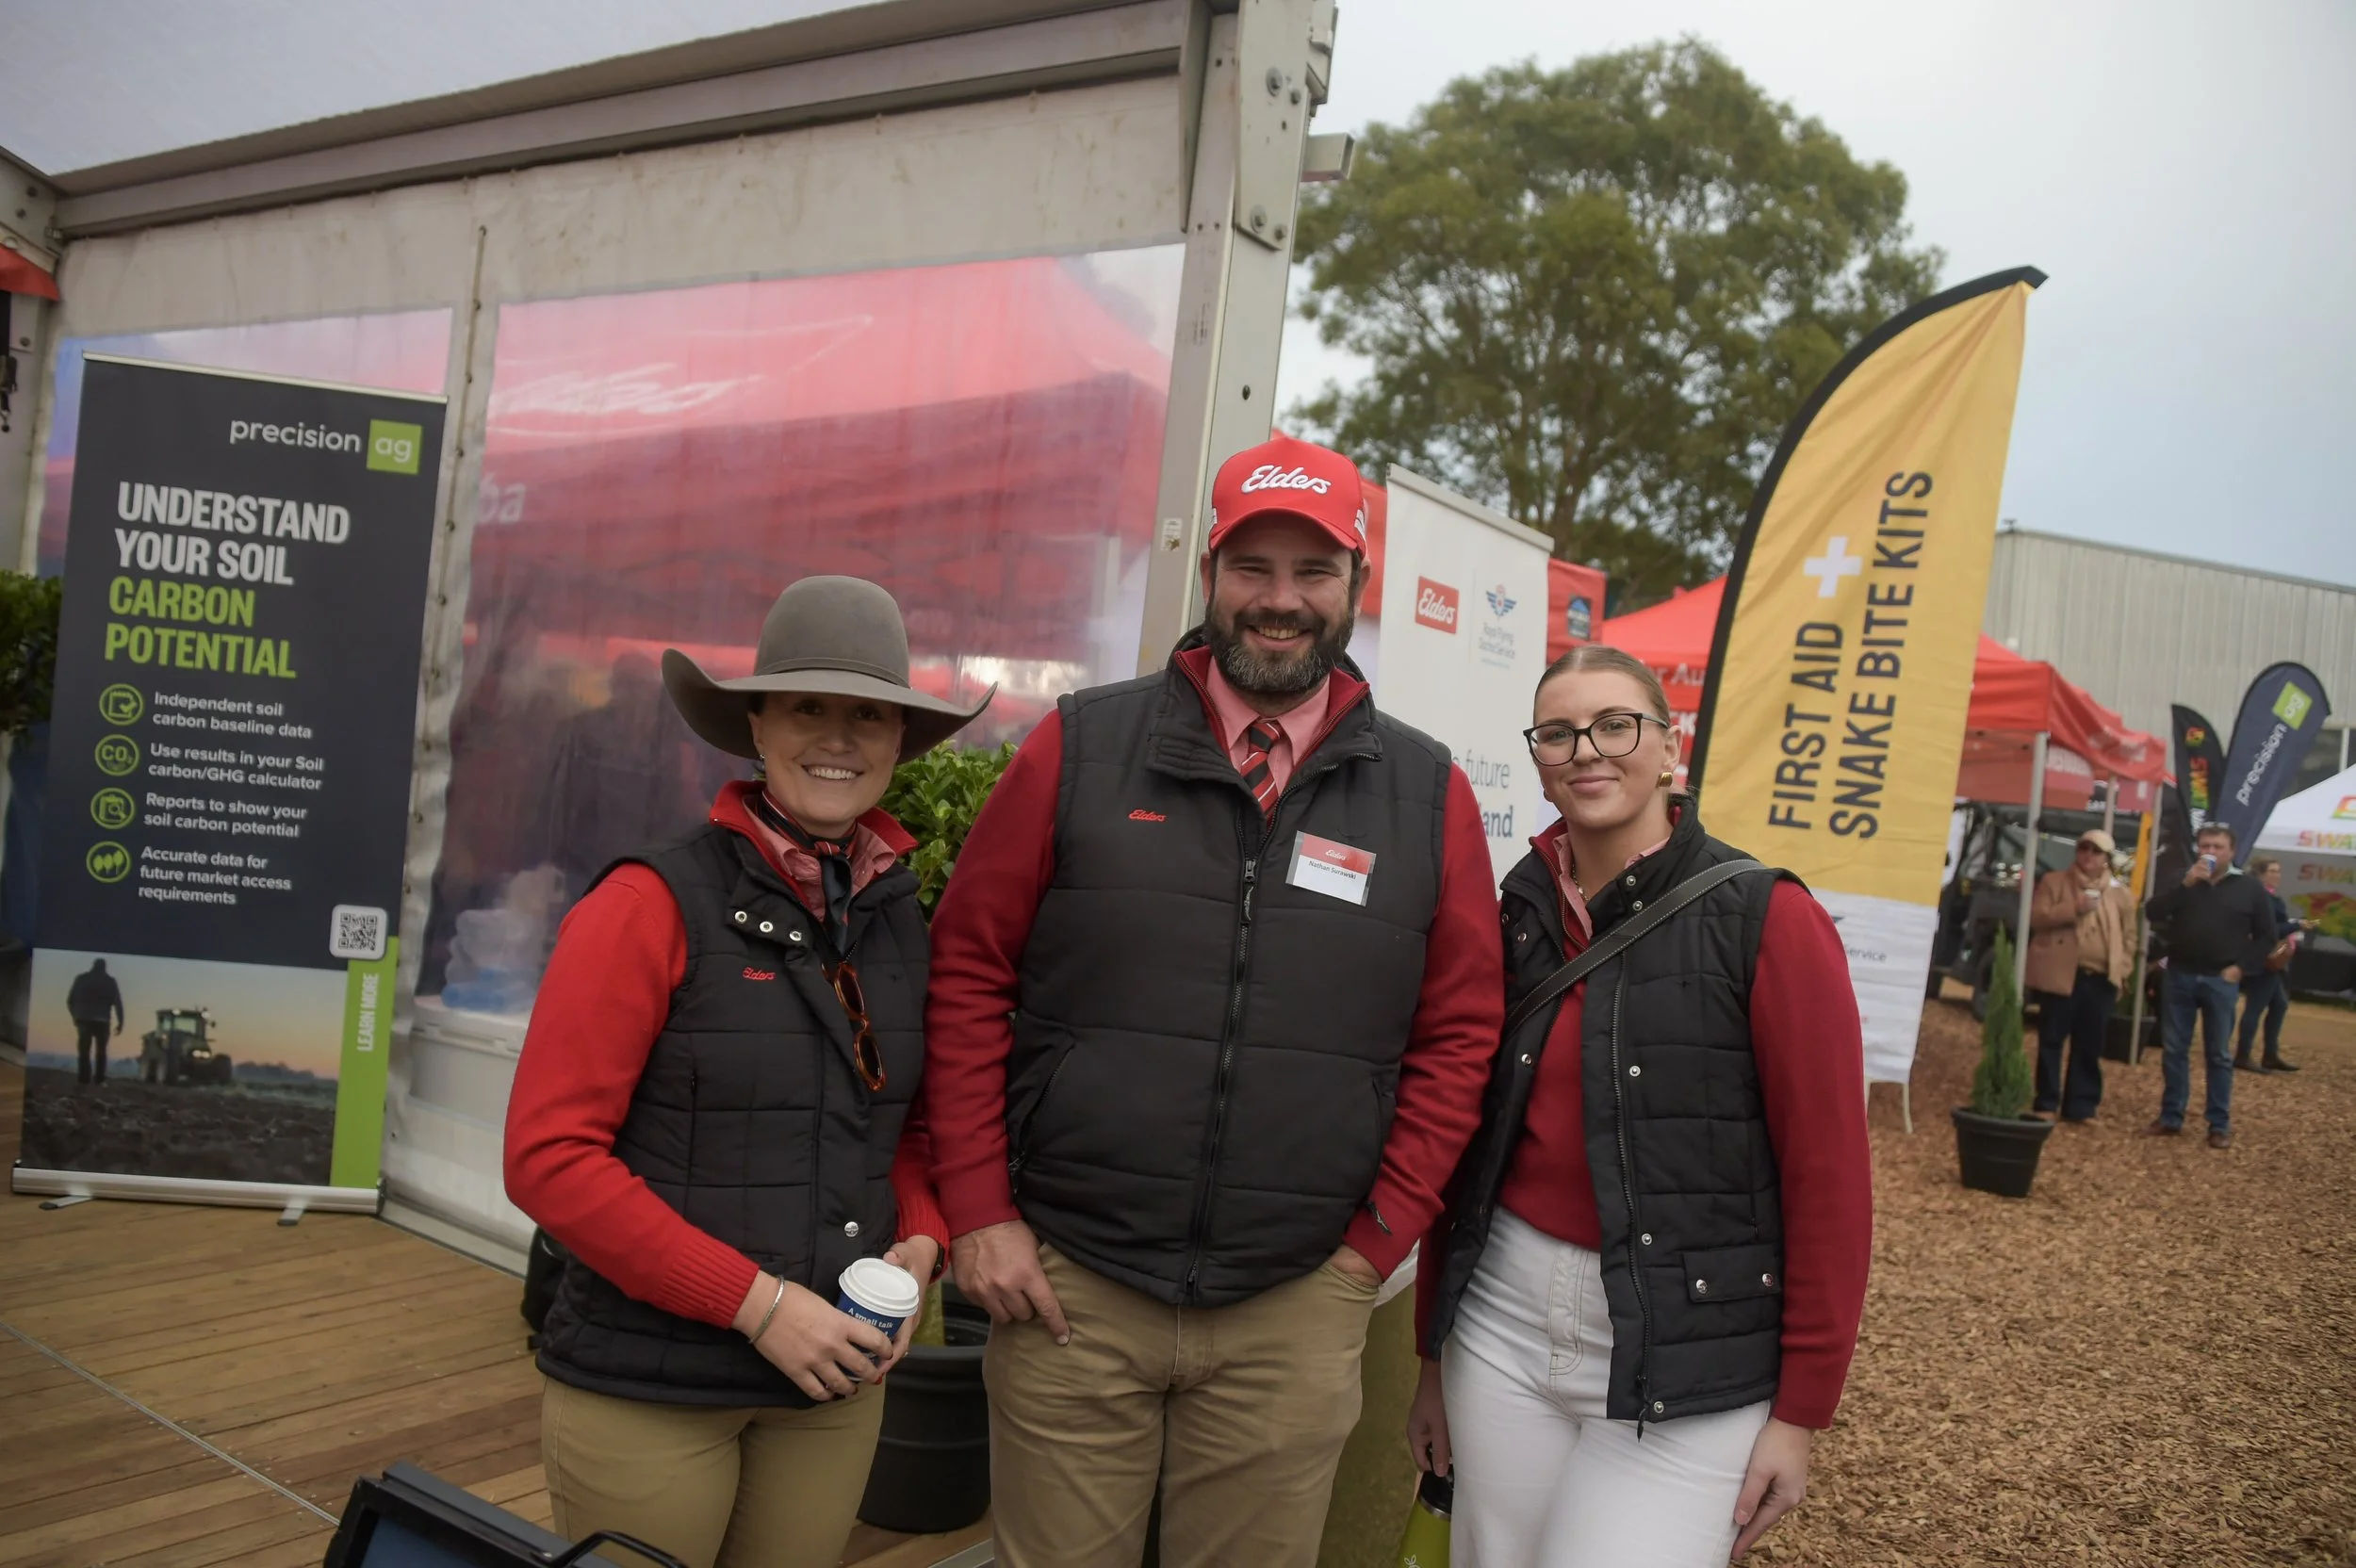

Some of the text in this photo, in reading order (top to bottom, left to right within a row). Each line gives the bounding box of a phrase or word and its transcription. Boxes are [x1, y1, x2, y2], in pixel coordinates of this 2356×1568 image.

[229, 420, 412, 463] precision ag
[1241, 465, 1331, 495] Elders
[118, 481, 350, 544] UNDERSTAND
[115, 529, 294, 585] YOUR SOIL
[109, 576, 254, 628] CARBON
[1418, 588, 1455, 625] Elders
[105, 623, 296, 678] POTENTIAL
[1828, 472, 1933, 839] SNAKE BITE KITS
[155, 692, 284, 717] Independent soil
[153, 712, 313, 740] carbon baseline data
[1768, 622, 1843, 829] FIRST AID
[150, 743, 324, 772] Use results in your Soil
[2236, 693, 2306, 807] precision ag
[148, 763, 321, 791] carbon/GHG calculator
[1466, 749, 1510, 789] future
[146, 792, 307, 821] Reports to show your
[1128, 808, 1167, 823] Elders
[1478, 801, 1513, 838] and
[143, 813, 300, 839] soil carbon potential
[2297, 829, 2356, 850] SWA
[141, 846, 269, 870] Accurate data for
[1309, 860, 1356, 880] Nathan Surawski
[139, 866, 292, 890] future market access
[2297, 863, 2356, 885] SWA
[139, 886, 237, 905] requirements
[743, 967, 776, 980] Elders
[357, 972, 379, 1051] LEARN MORE
[848, 1307, 854, 1316] A
[855, 1313, 877, 1327] small
